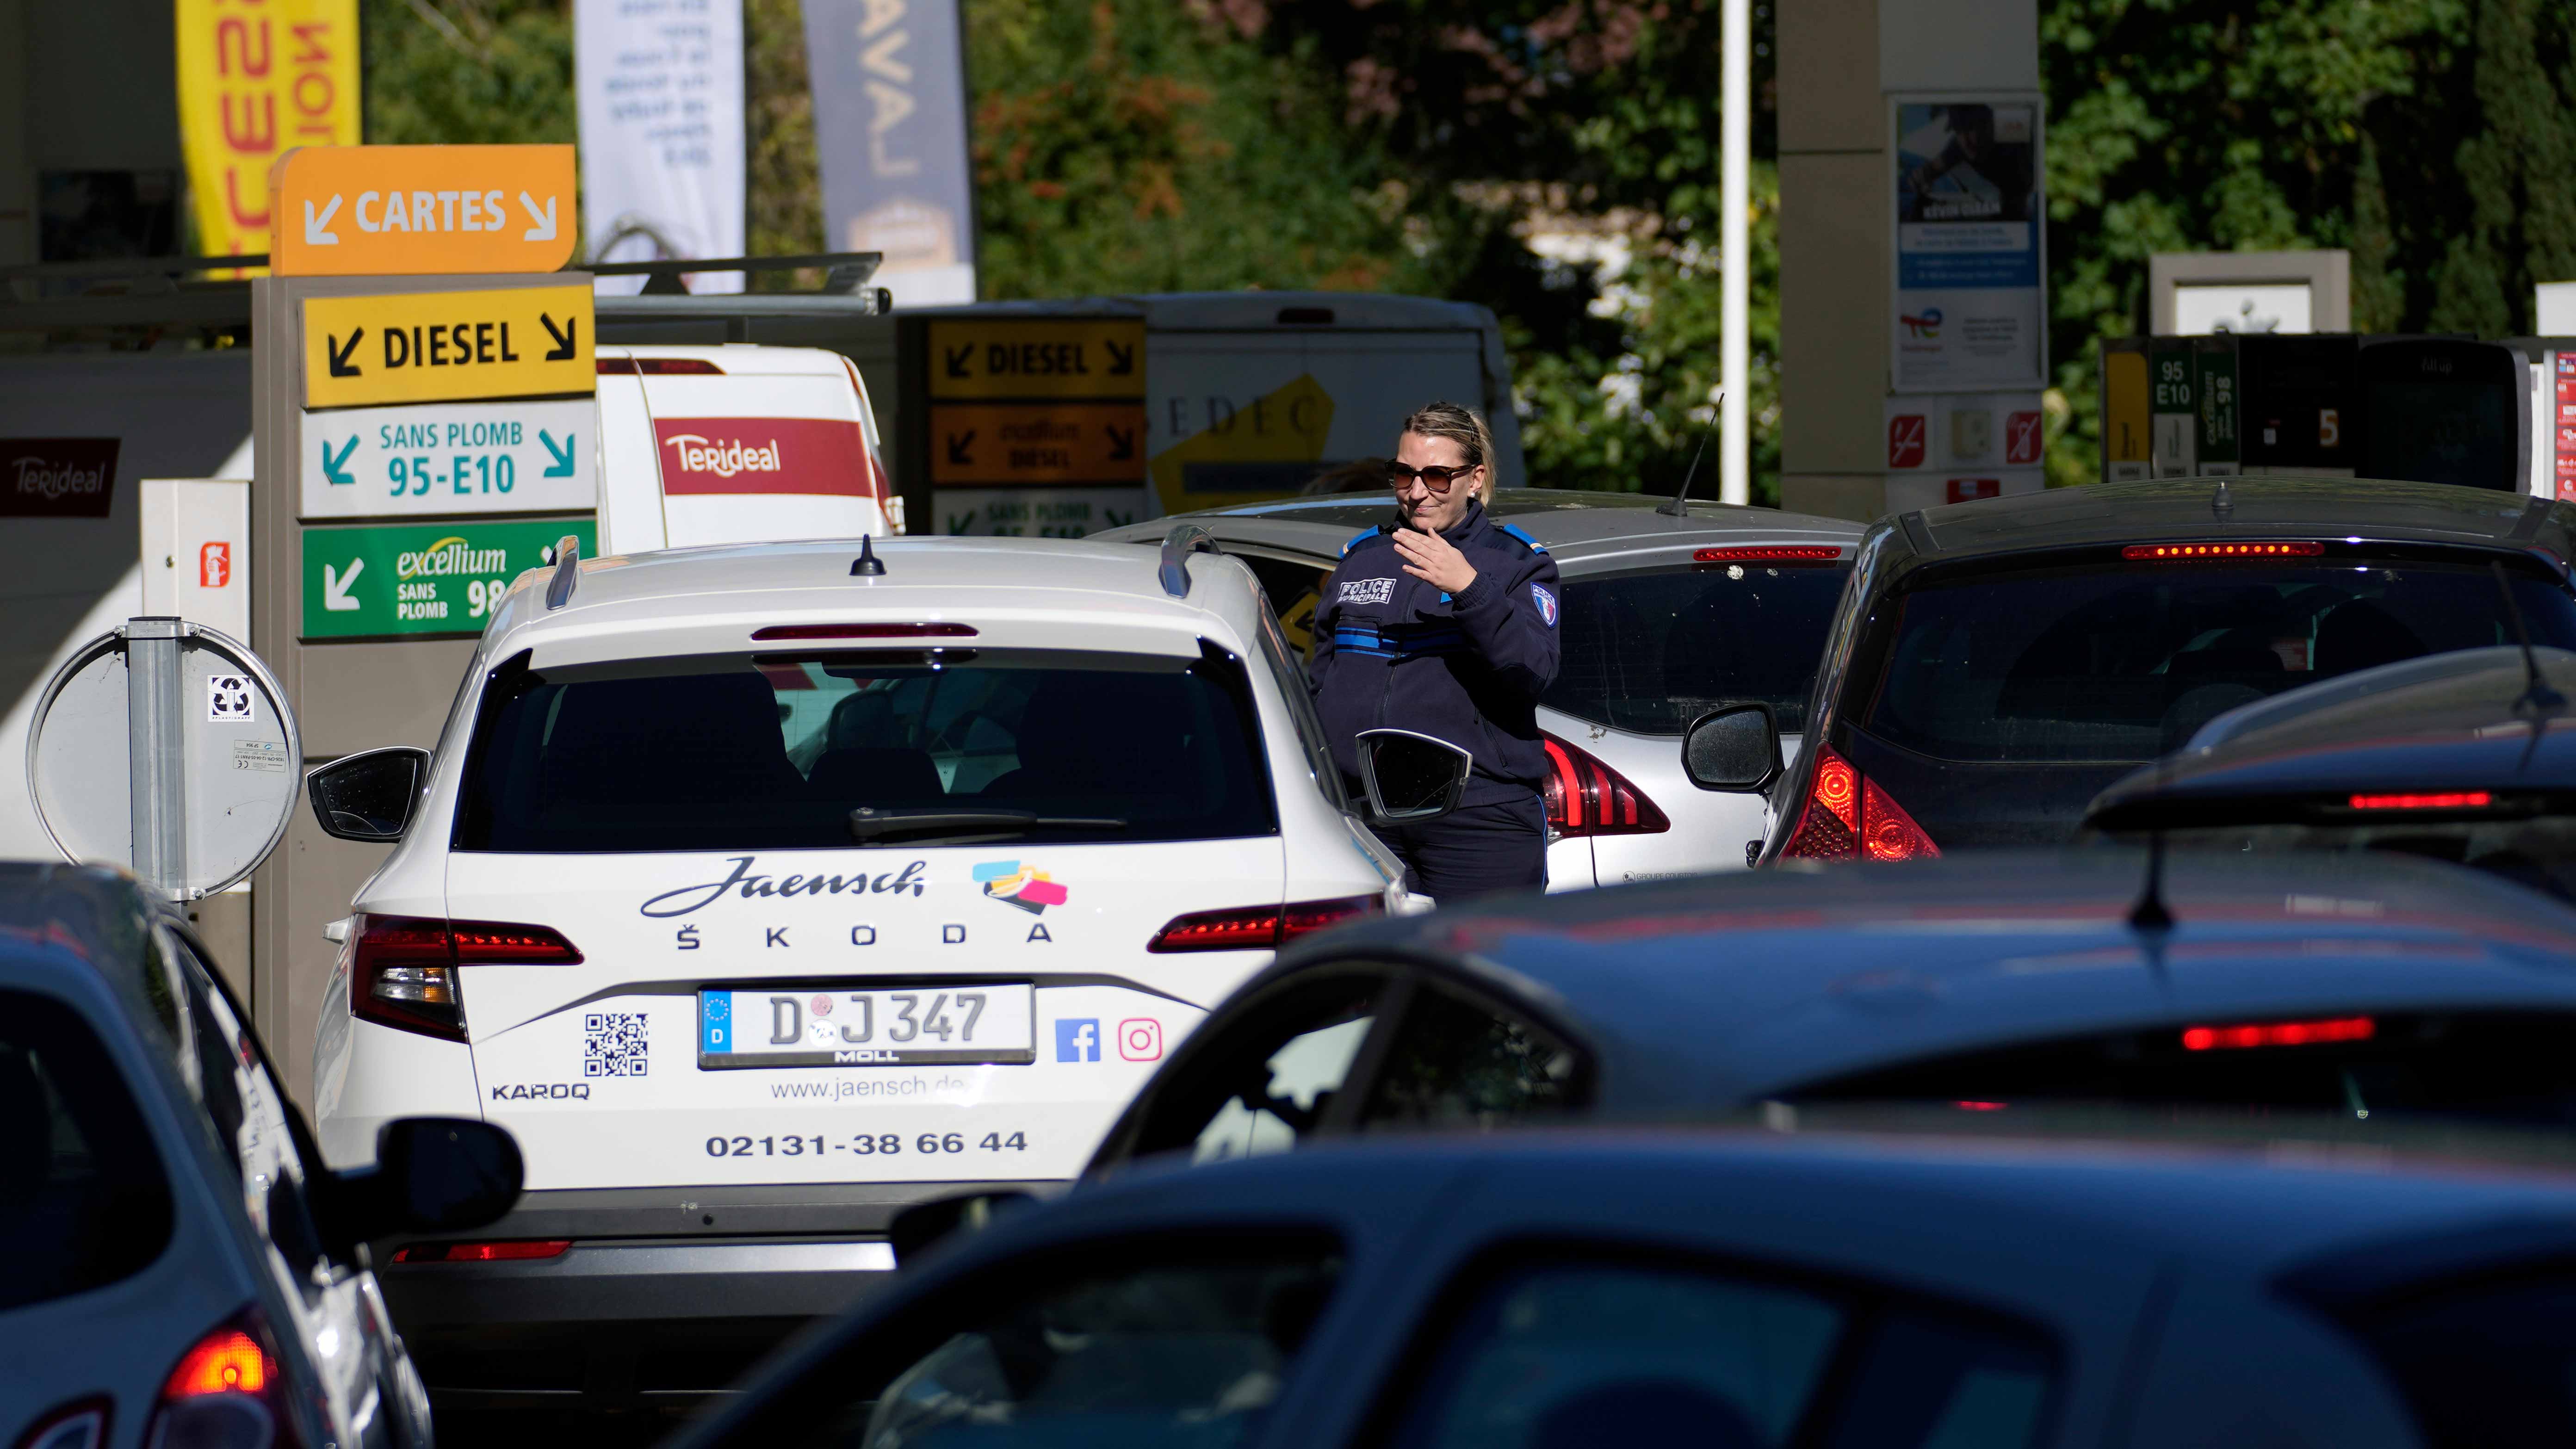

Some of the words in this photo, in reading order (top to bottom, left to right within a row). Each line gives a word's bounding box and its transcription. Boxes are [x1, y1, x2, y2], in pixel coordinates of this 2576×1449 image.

[355, 190, 506, 232] CARTES
[384, 322, 519, 369] DIESEL
[988, 343, 1088, 374] DIESEL
[2161, 360, 2184, 382] 95
[2156, 384, 2191, 405] E10
[2216, 376, 2232, 404] 98
[1146, 395, 1318, 437] EDEC
[2319, 409, 2338, 446] 5
[380, 423, 438, 449] SANS
[447, 421, 523, 448] PLOMB
[389, 454, 515, 497] 95-E10
[986, 503, 1029, 521] SANS
[1036, 502, 1092, 520] PLOMB
[396, 541, 506, 577] excellium
[398, 582, 437, 601] SANS
[467, 580, 506, 618] 98
[1341, 580, 1393, 596] POLICE
[398, 602, 448, 620] PLOMB
[640, 856, 927, 918] Jaensch
[770, 997, 802, 1044] D
[842, 994, 873, 1043] J
[889, 993, 986, 1041] 347
[711, 1029, 724, 1044] D
[834, 1050, 900, 1063] MOLL
[492, 1083, 590, 1100] KAROQ
[771, 1074, 964, 1102] www.jaenschde
[916, 1132, 964, 1154] 66
[979, 1131, 1028, 1152] 44
